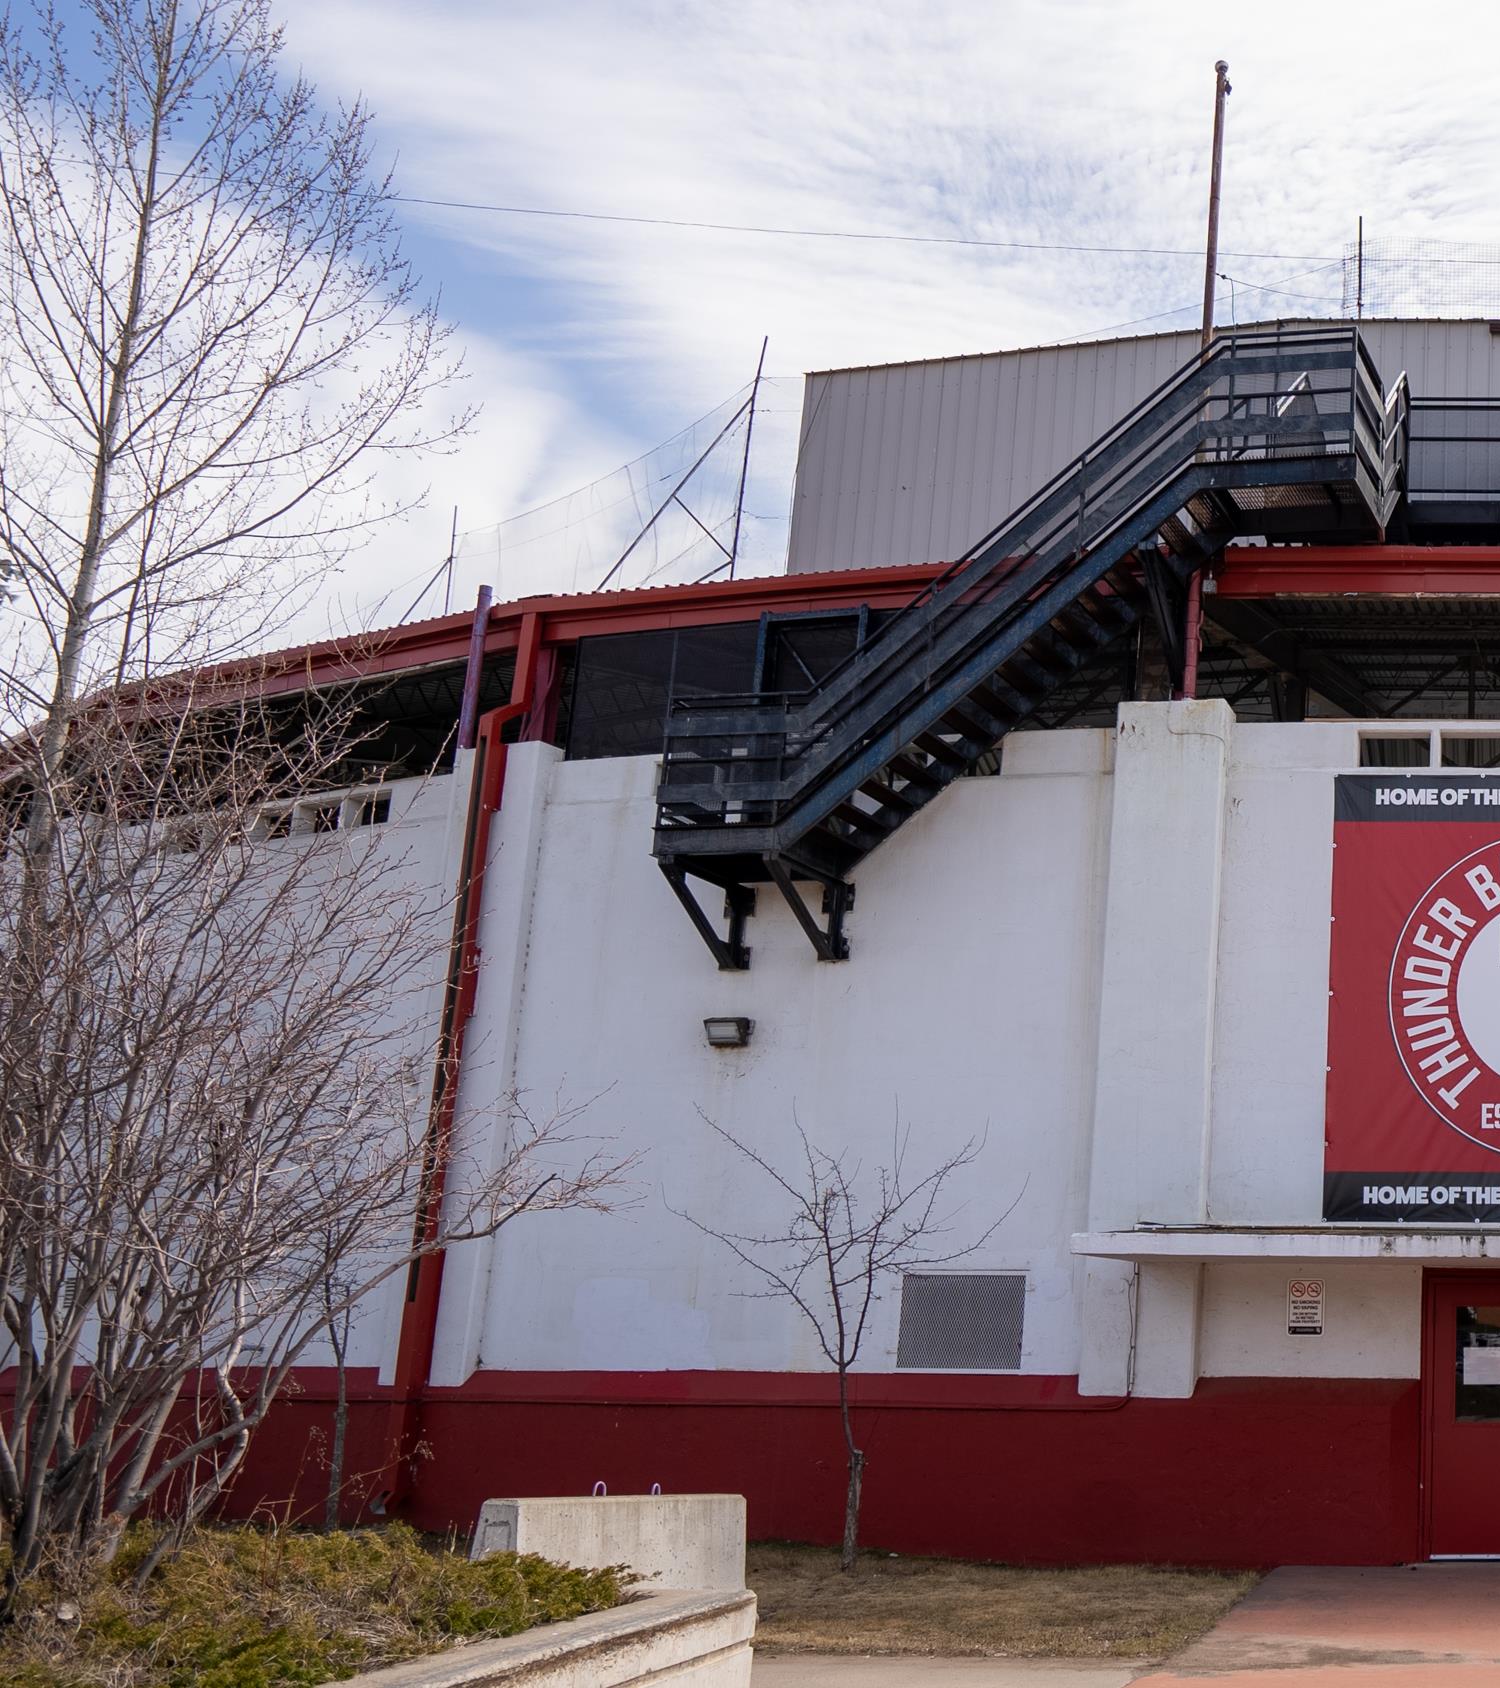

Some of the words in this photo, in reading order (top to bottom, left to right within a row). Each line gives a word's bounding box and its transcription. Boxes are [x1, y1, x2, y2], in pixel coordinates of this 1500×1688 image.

[1375, 789, 1439, 806] HOME
[1440, 789, 1470, 806] OF
[1402, 897, 1481, 1110] THUNDER
[1363, 1186, 1430, 1205] HOME
[1430, 1186, 1461, 1205] OF
